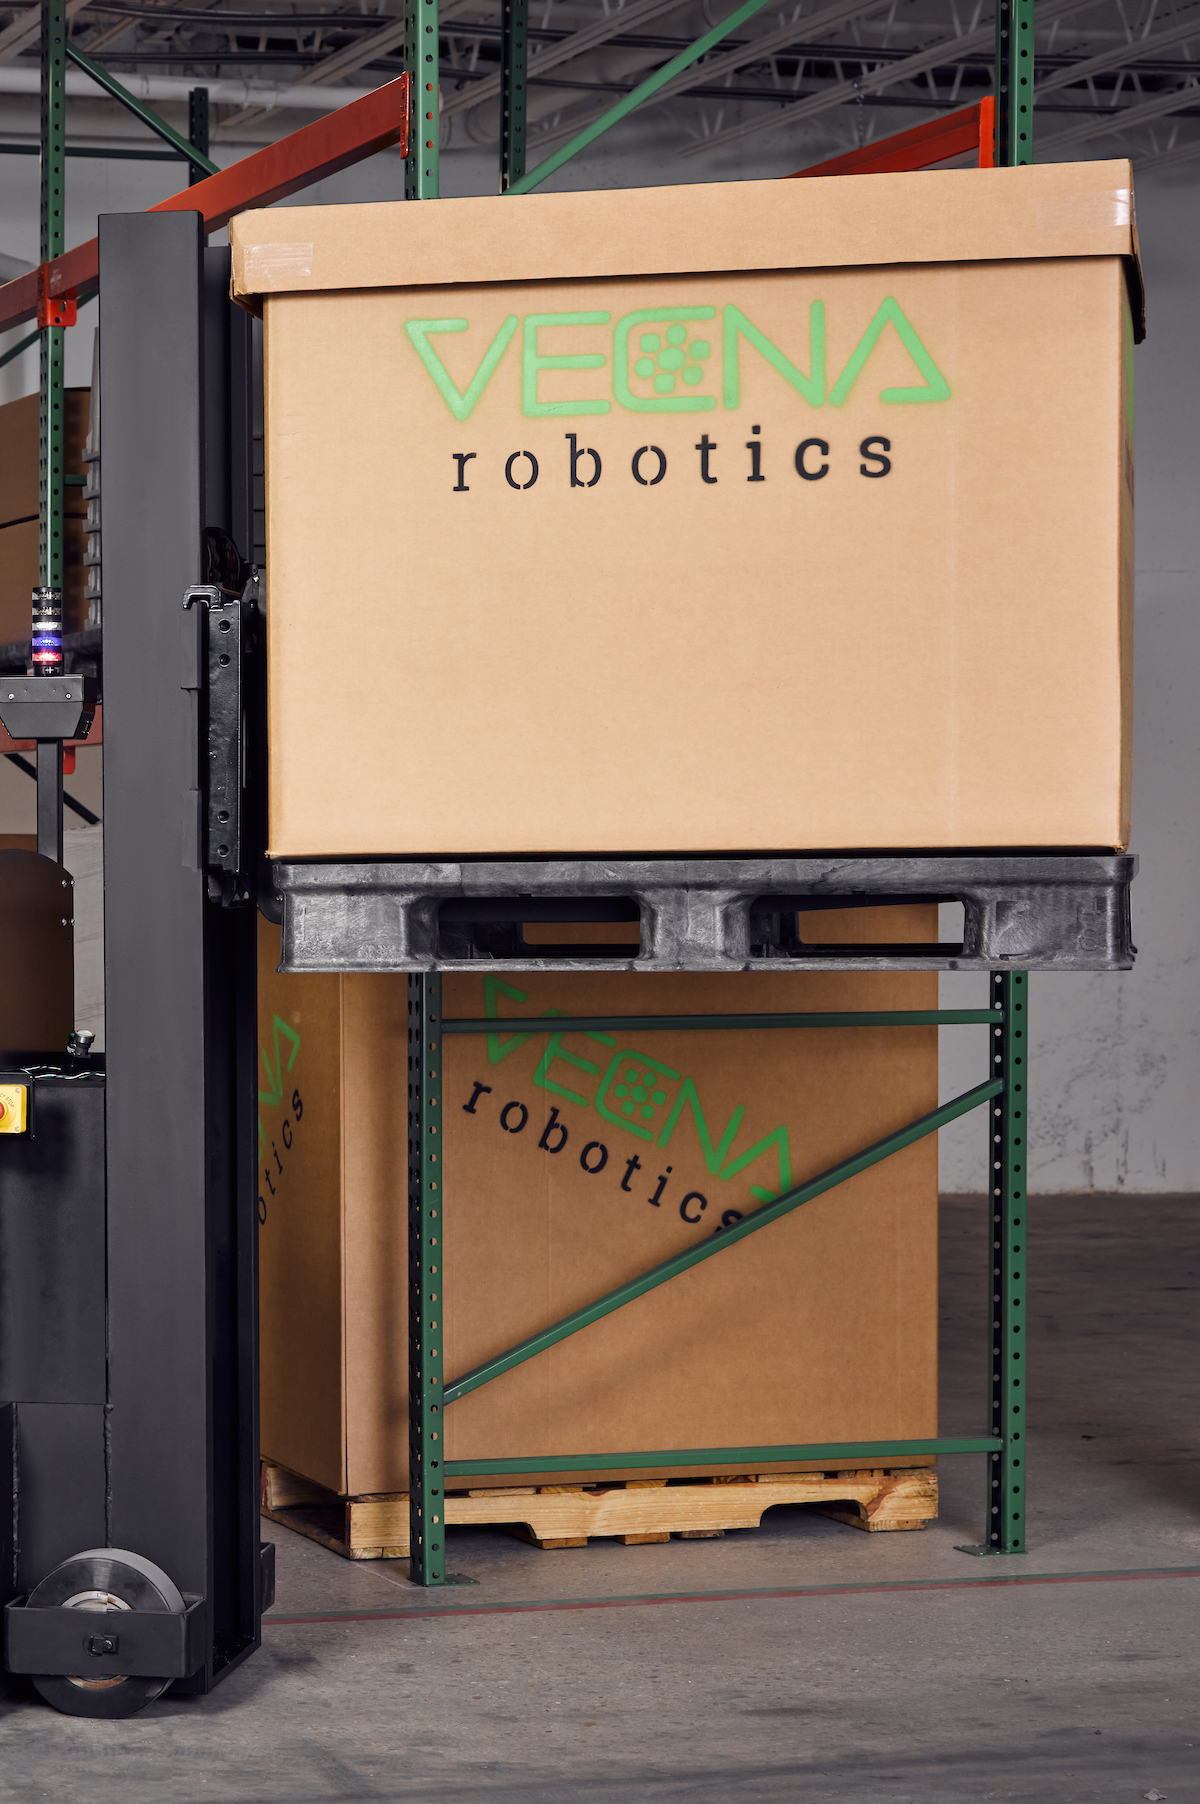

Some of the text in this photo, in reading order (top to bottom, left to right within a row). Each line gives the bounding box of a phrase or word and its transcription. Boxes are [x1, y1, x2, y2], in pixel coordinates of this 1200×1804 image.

[404, 296, 952, 421] VECNA
[452, 424, 893, 492] robotics
[5, 1096, 15, 1108] STOP
[483, 974, 793, 1204] VECNA
[257, 1088, 303, 1226] otics
